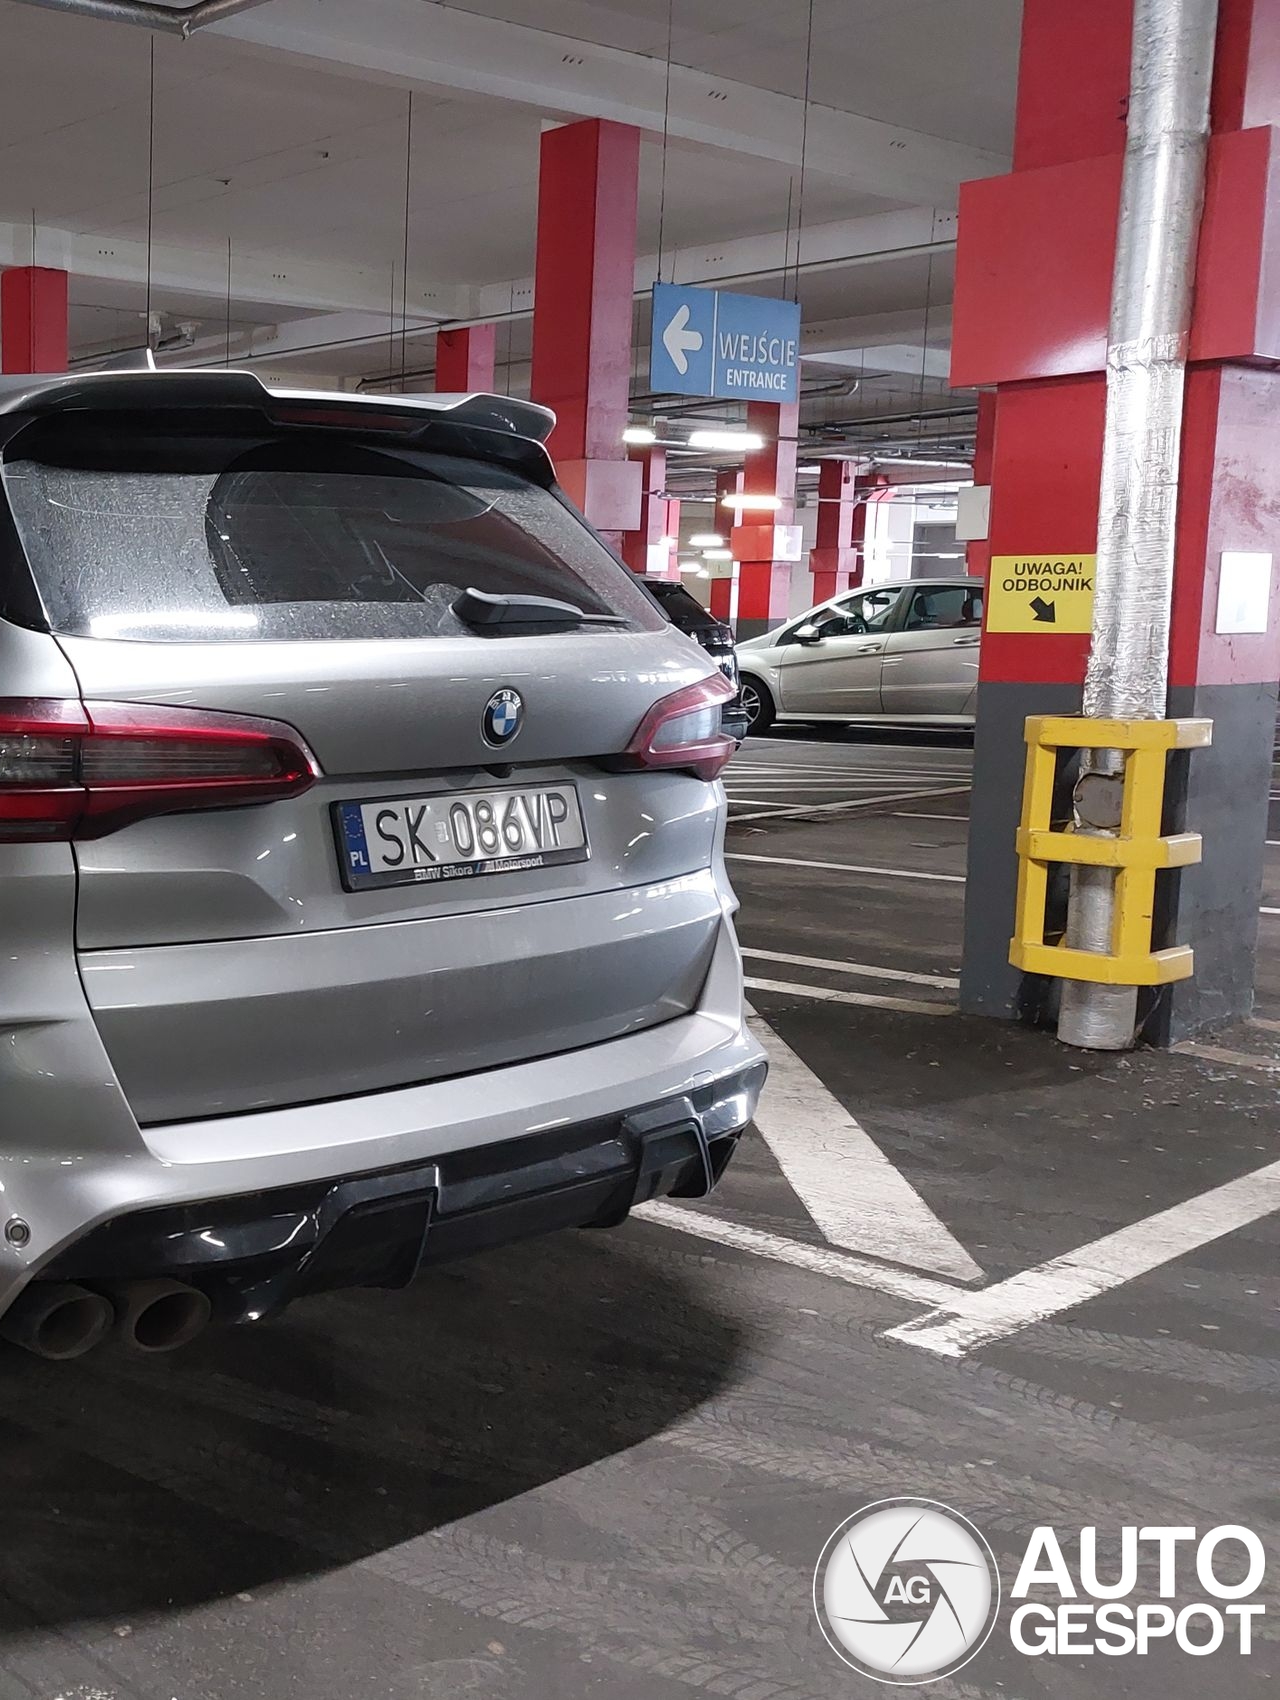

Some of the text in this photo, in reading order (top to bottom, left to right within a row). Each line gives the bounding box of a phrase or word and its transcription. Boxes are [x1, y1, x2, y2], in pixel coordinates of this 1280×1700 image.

[720, 330, 796, 367] WEJŚCIE
[726, 368, 787, 390] ENTRANCE
[1014, 562, 1083, 575] UWAGA!
[1002, 577, 1093, 591] ODBOJNIK
[376, 792, 568, 866] SK 086VP
[350, 851, 368, 867] PL
[414, 867, 441, 881] BMW
[442, 865, 474, 878] Sikora
[495, 855, 545, 872] Motorsport
